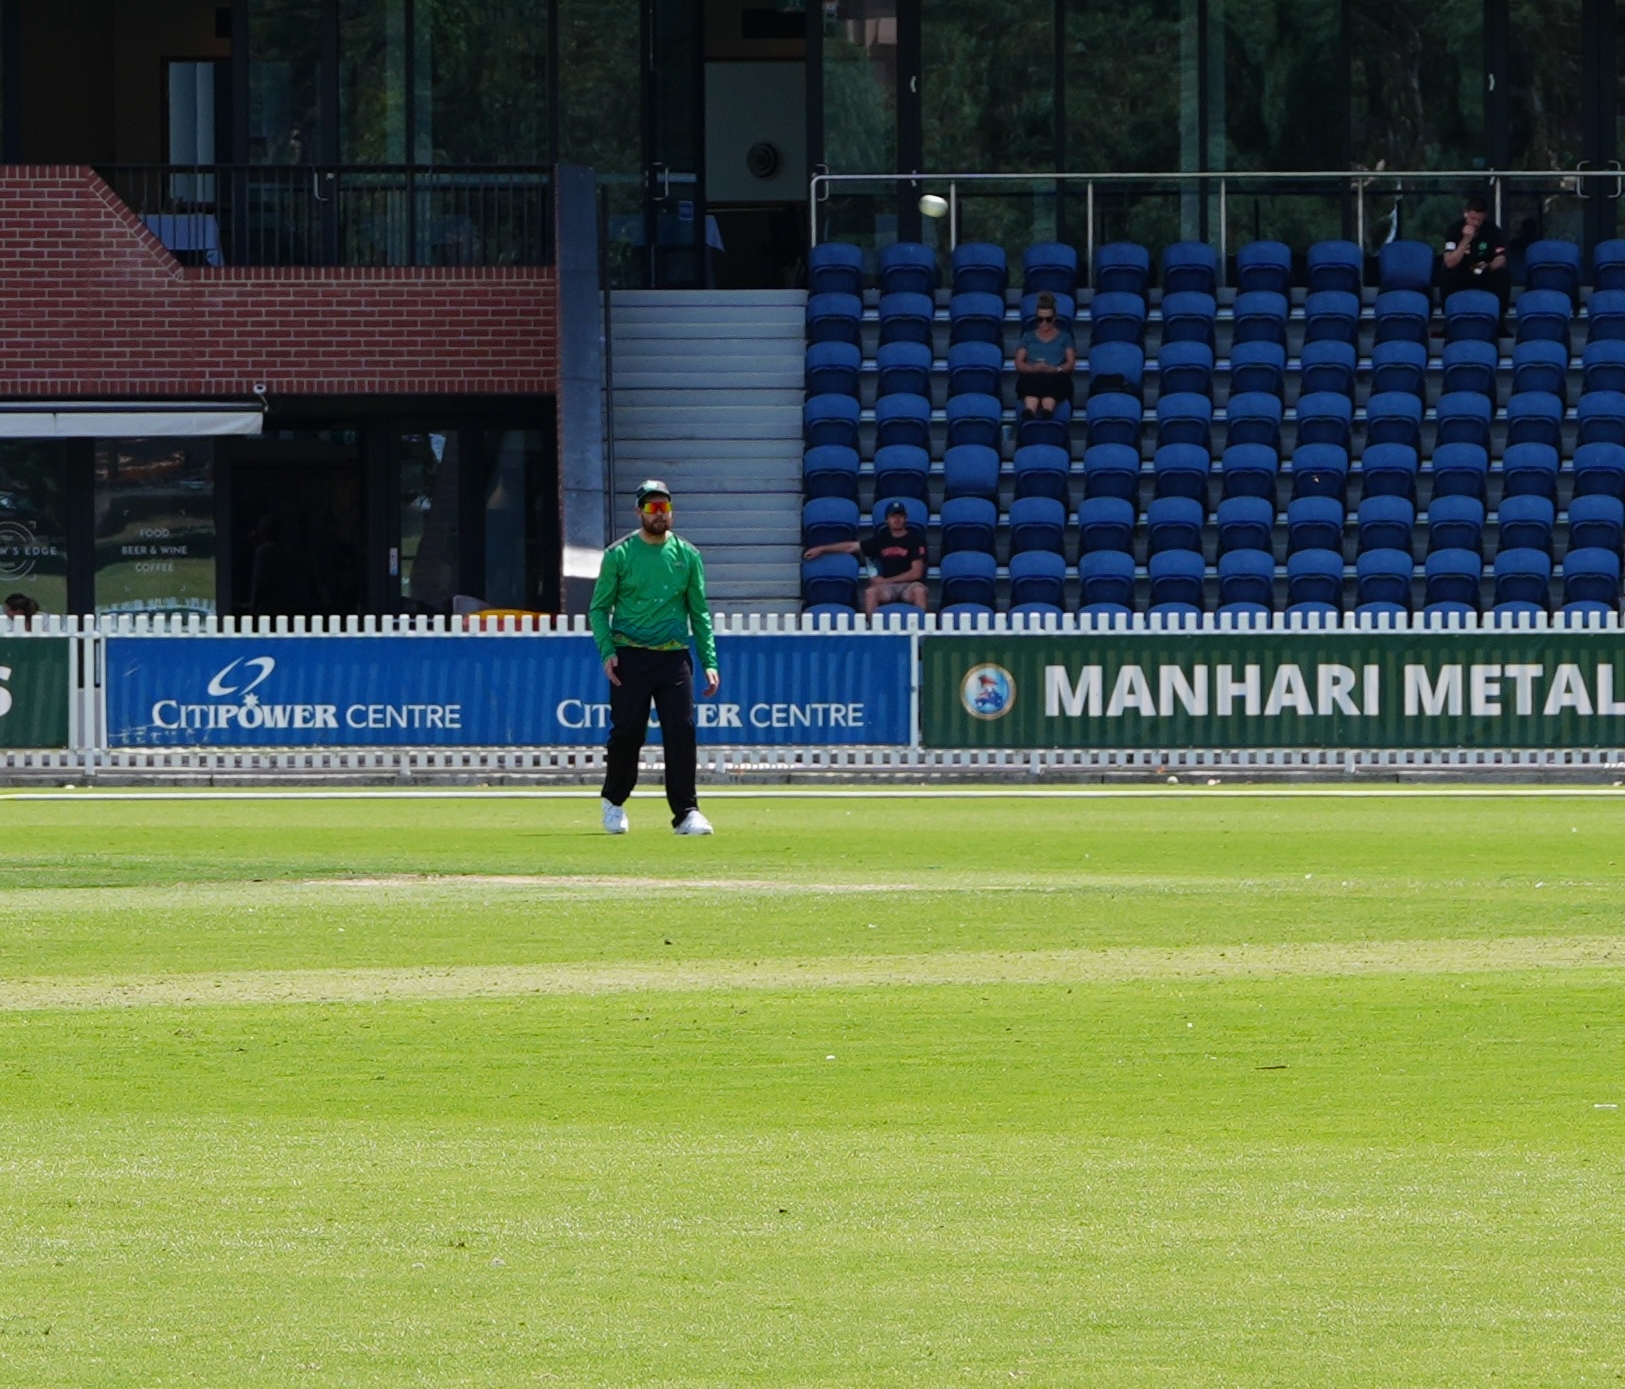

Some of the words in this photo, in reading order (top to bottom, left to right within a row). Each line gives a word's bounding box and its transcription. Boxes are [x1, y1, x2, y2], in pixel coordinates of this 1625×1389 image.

[24, 546, 57, 556] EDGE
[1045, 664, 1379, 717] MANHARI
[346, 704, 462, 728] CENTRE
[750, 703, 865, 728] CENTRE
